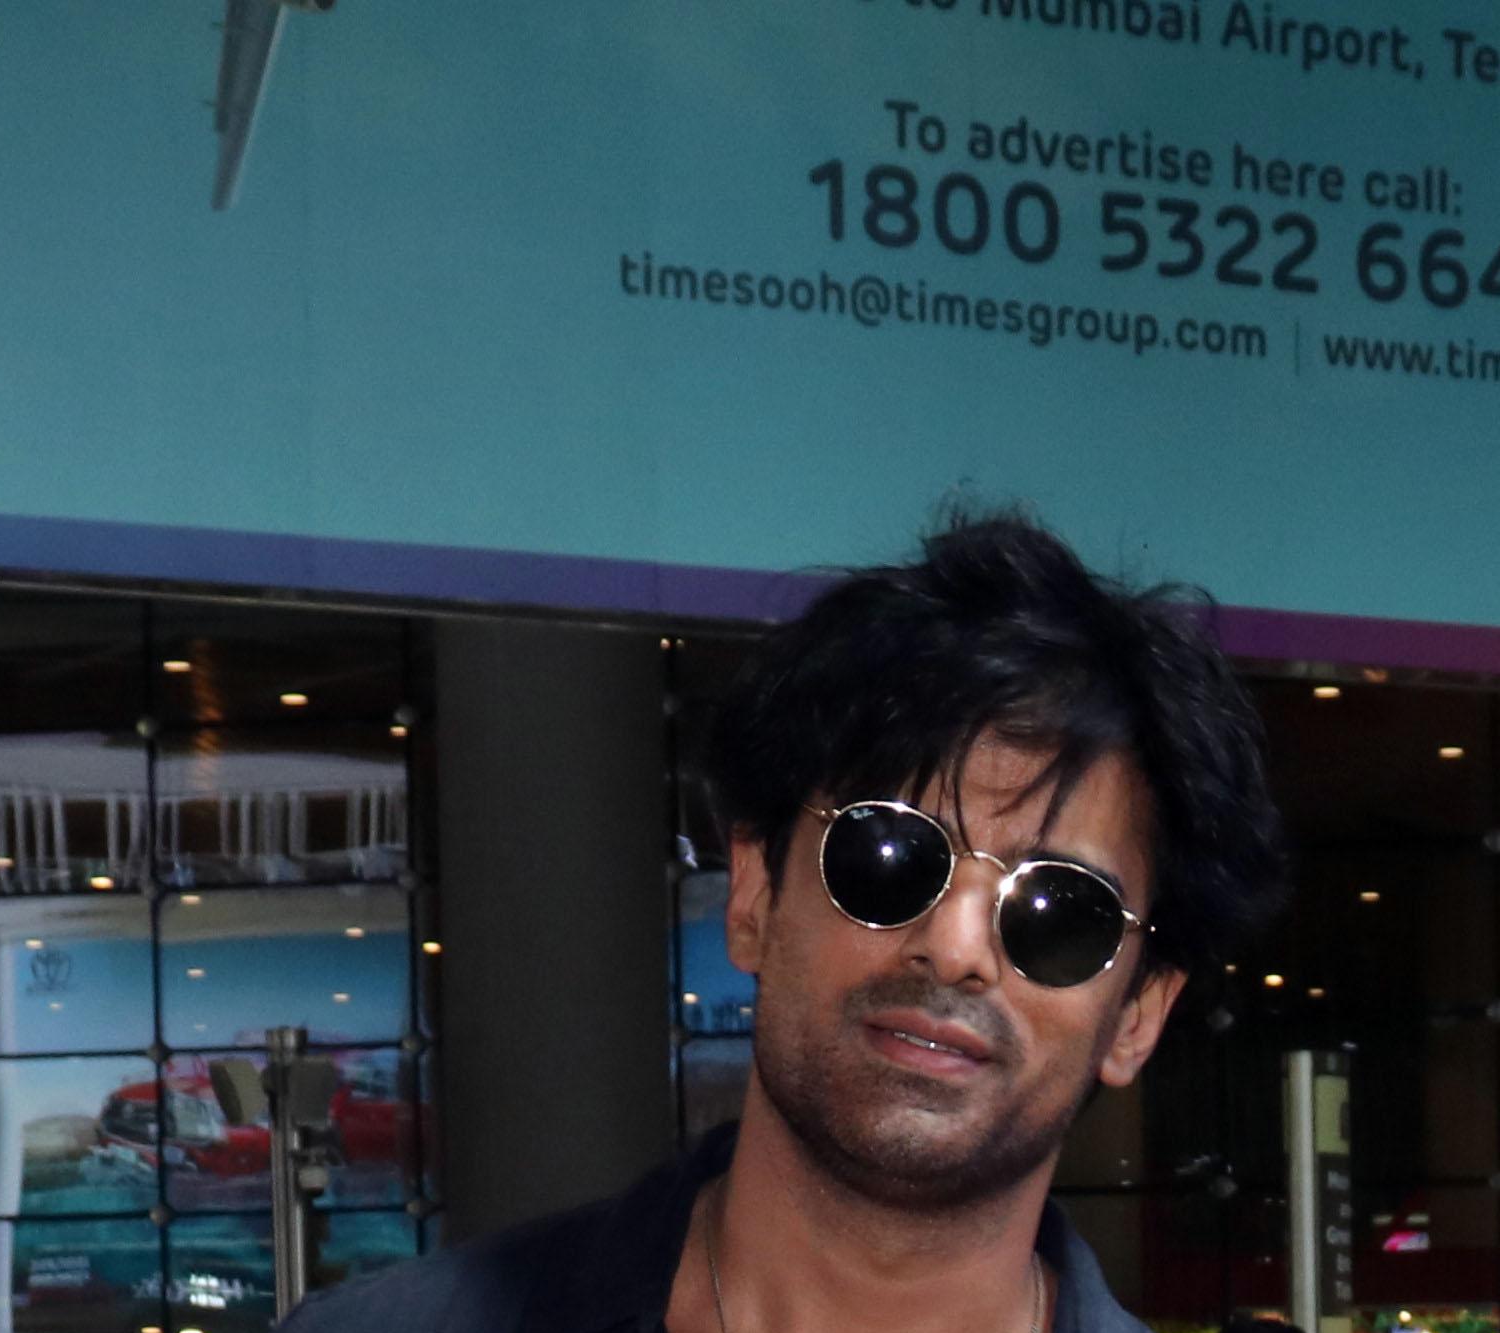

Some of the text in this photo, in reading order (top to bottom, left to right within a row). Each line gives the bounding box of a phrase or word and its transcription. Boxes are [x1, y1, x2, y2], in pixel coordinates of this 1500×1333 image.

[1220, 0, 1425, 81] Airport,
[884, 99, 1463, 217] To advertise here call:
[808, 157, 1061, 264] 1800
[1101, 191, 1319, 294] 5322
[619, 251, 1267, 357] timesooh@timesgroup.com
